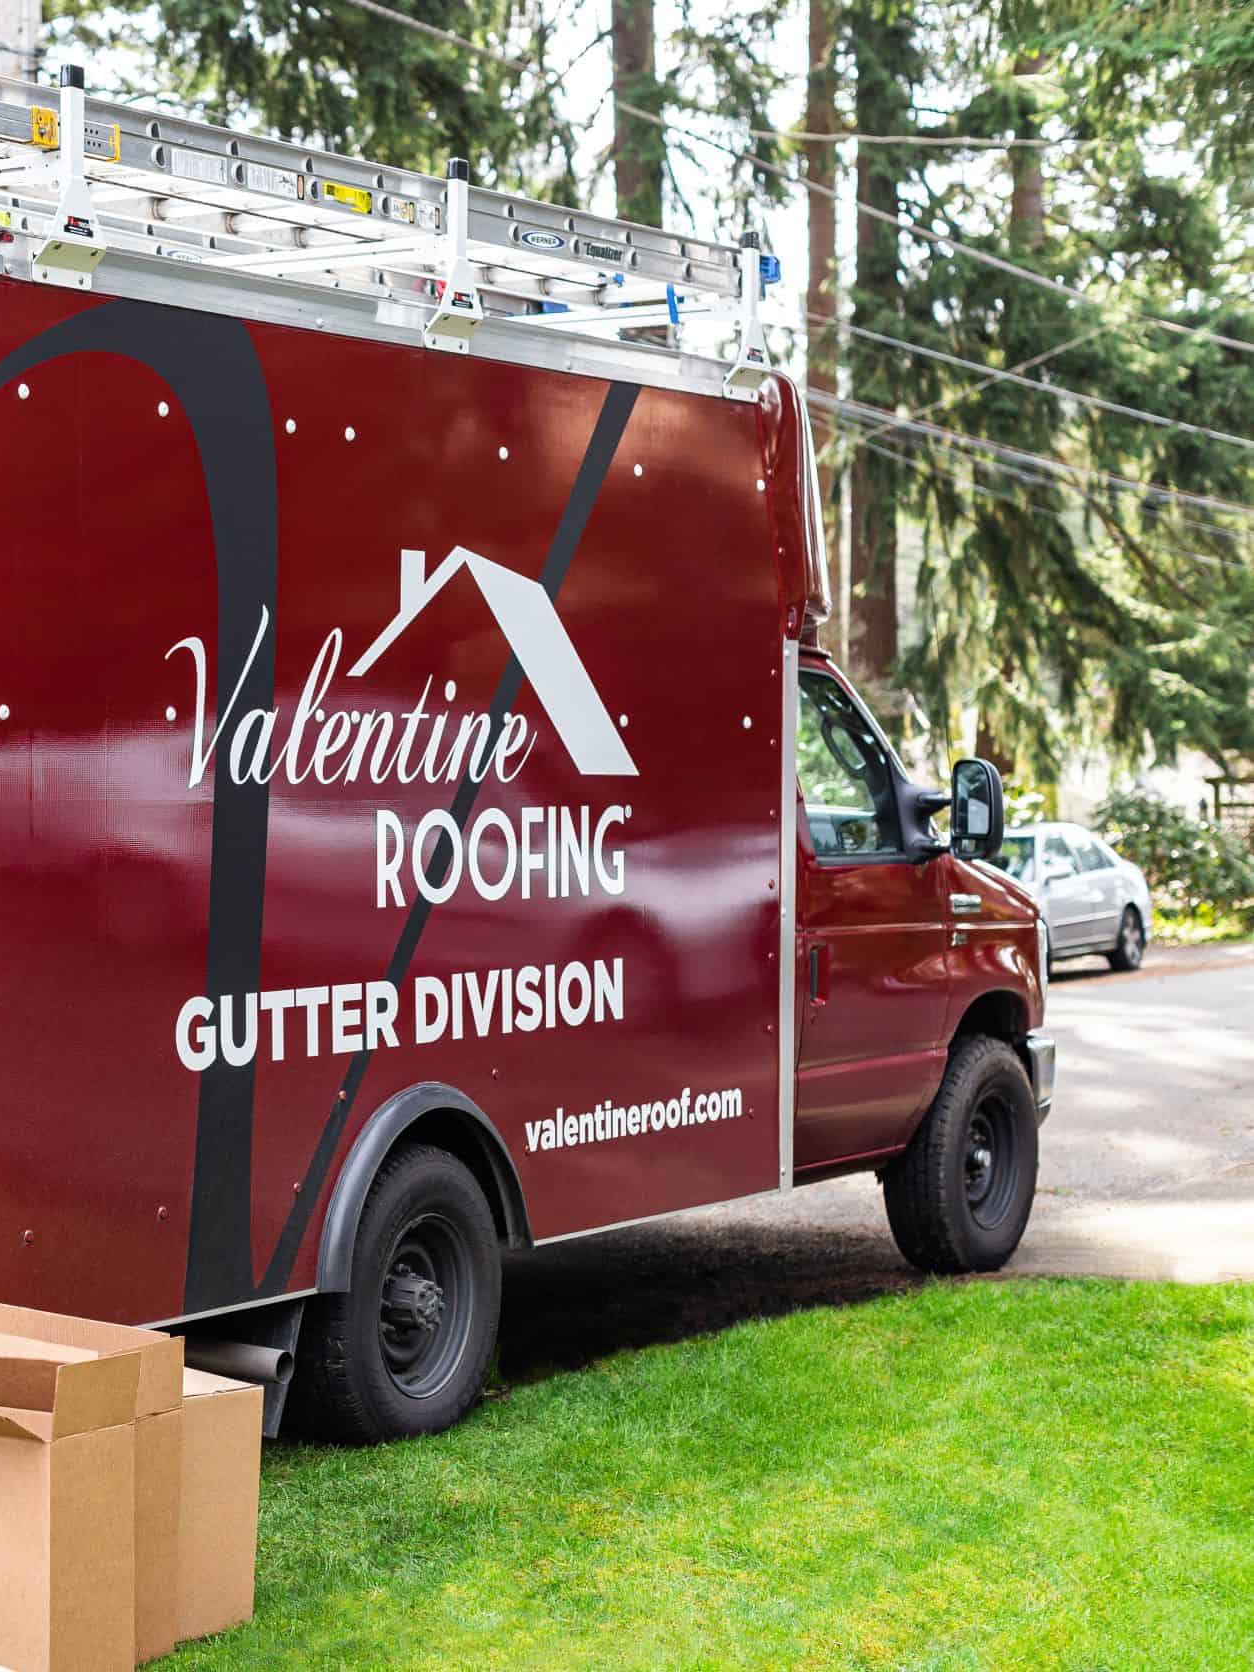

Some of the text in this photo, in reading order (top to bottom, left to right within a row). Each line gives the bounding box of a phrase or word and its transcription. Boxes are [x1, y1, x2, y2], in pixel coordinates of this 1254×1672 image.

[584, 242, 623, 261] Equalizer
[164, 603, 538, 790] Valentine
[375, 804, 626, 909] ROOFING
[174, 957, 625, 1073] GUTTER DIVISION
[524, 1085, 743, 1153] valentineroof.com
